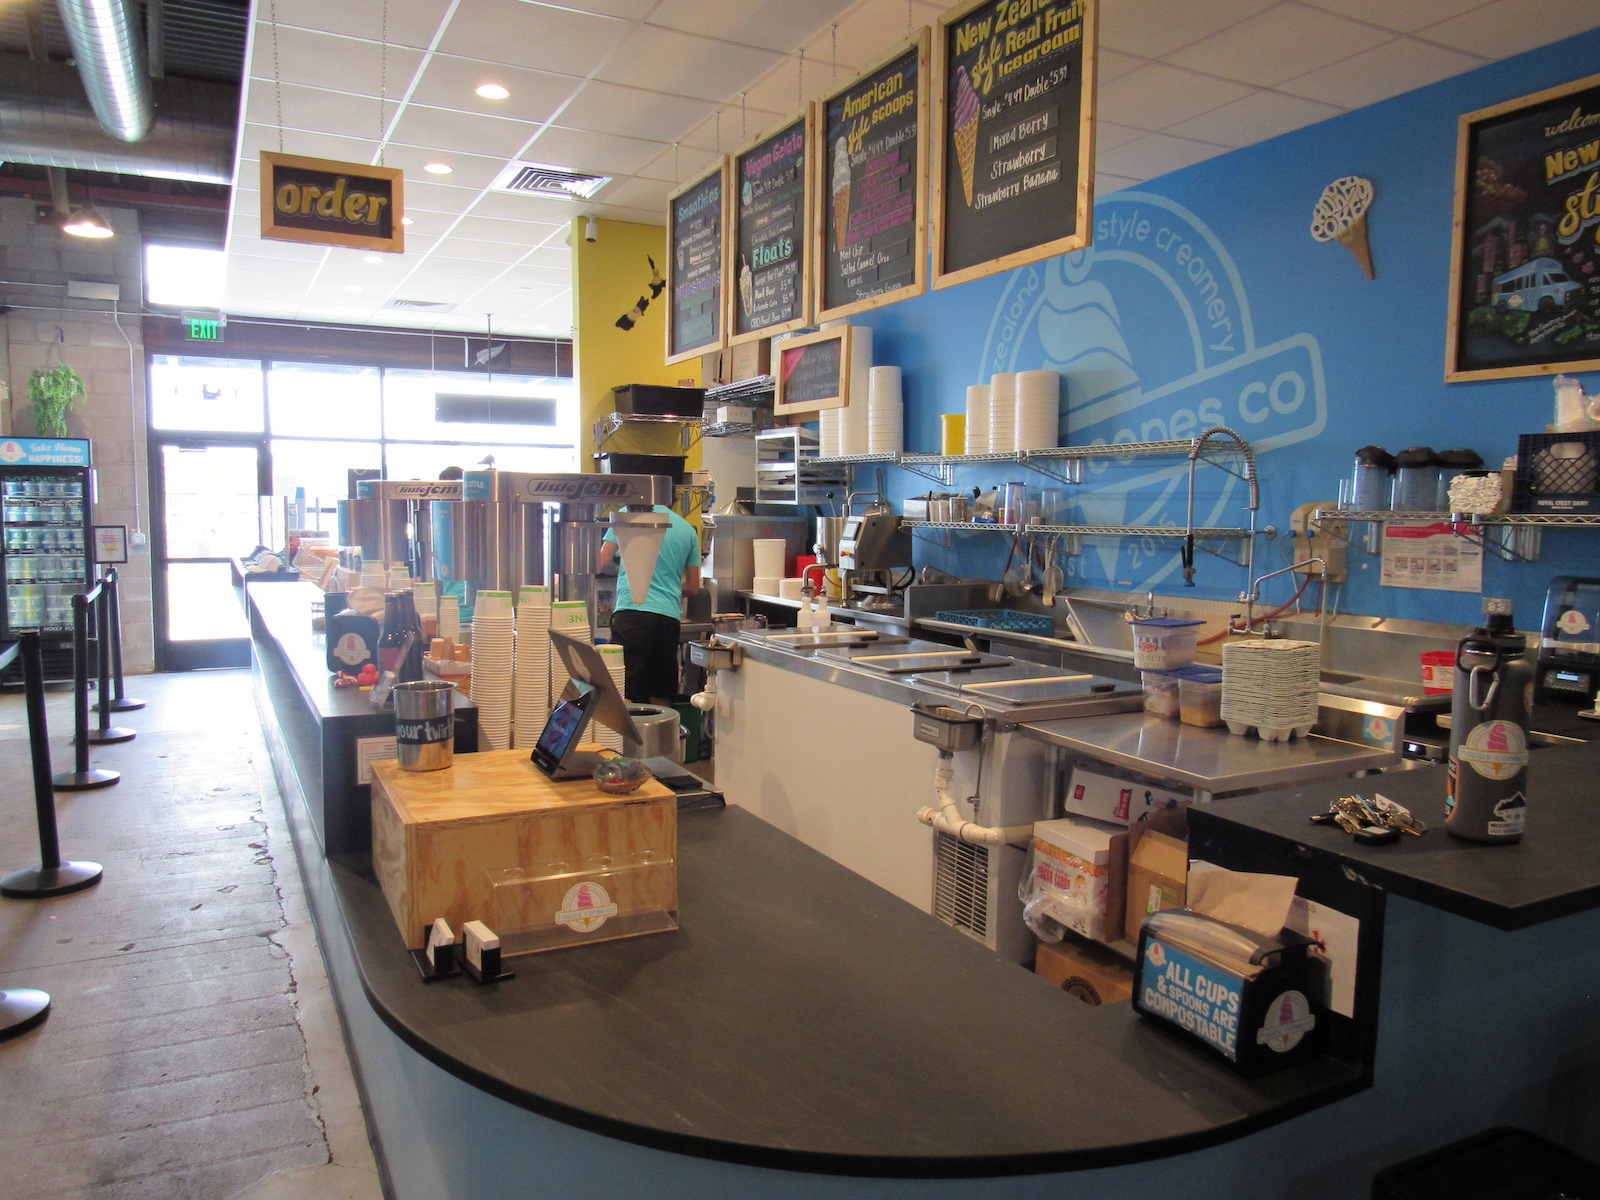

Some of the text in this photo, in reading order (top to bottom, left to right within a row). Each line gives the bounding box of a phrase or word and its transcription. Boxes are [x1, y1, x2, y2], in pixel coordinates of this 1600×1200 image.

[956, 0, 1055, 56] New Zeal
[971, 0, 1084, 96] style Real Fruit
[842, 72, 903, 122] American
[872, 90, 913, 125] scoops
[1024, 76, 1050, 100] Double
[993, 113, 1048, 150] Mixed Berry
[1545, 107, 1600, 137] welcom
[746, 133, 803, 178] Vegan Gelato
[991, 143, 1046, 180] Strawberry
[1545, 140, 1600, 179] New
[276, 178, 388, 223] order
[679, 187, 719, 223] Smoothies
[975, 169, 1059, 210] Strawberry Banana
[752, 238, 792, 269] Floats
[1097, 210, 1236, 352] style creamery
[191, 320, 219, 339] EXIT
[992, 266, 1039, 375] zealand
[28, 455, 84, 464] HAPPINESS!
[1157, 975, 1167, 995] &
[1169, 984, 1210, 1018] SPOONS
[1212, 1008, 1237, 1033] ARE
[1165, 961, 1240, 1013] ALL CUPS
[1144, 986, 1236, 1052] COMPOSTABLE
